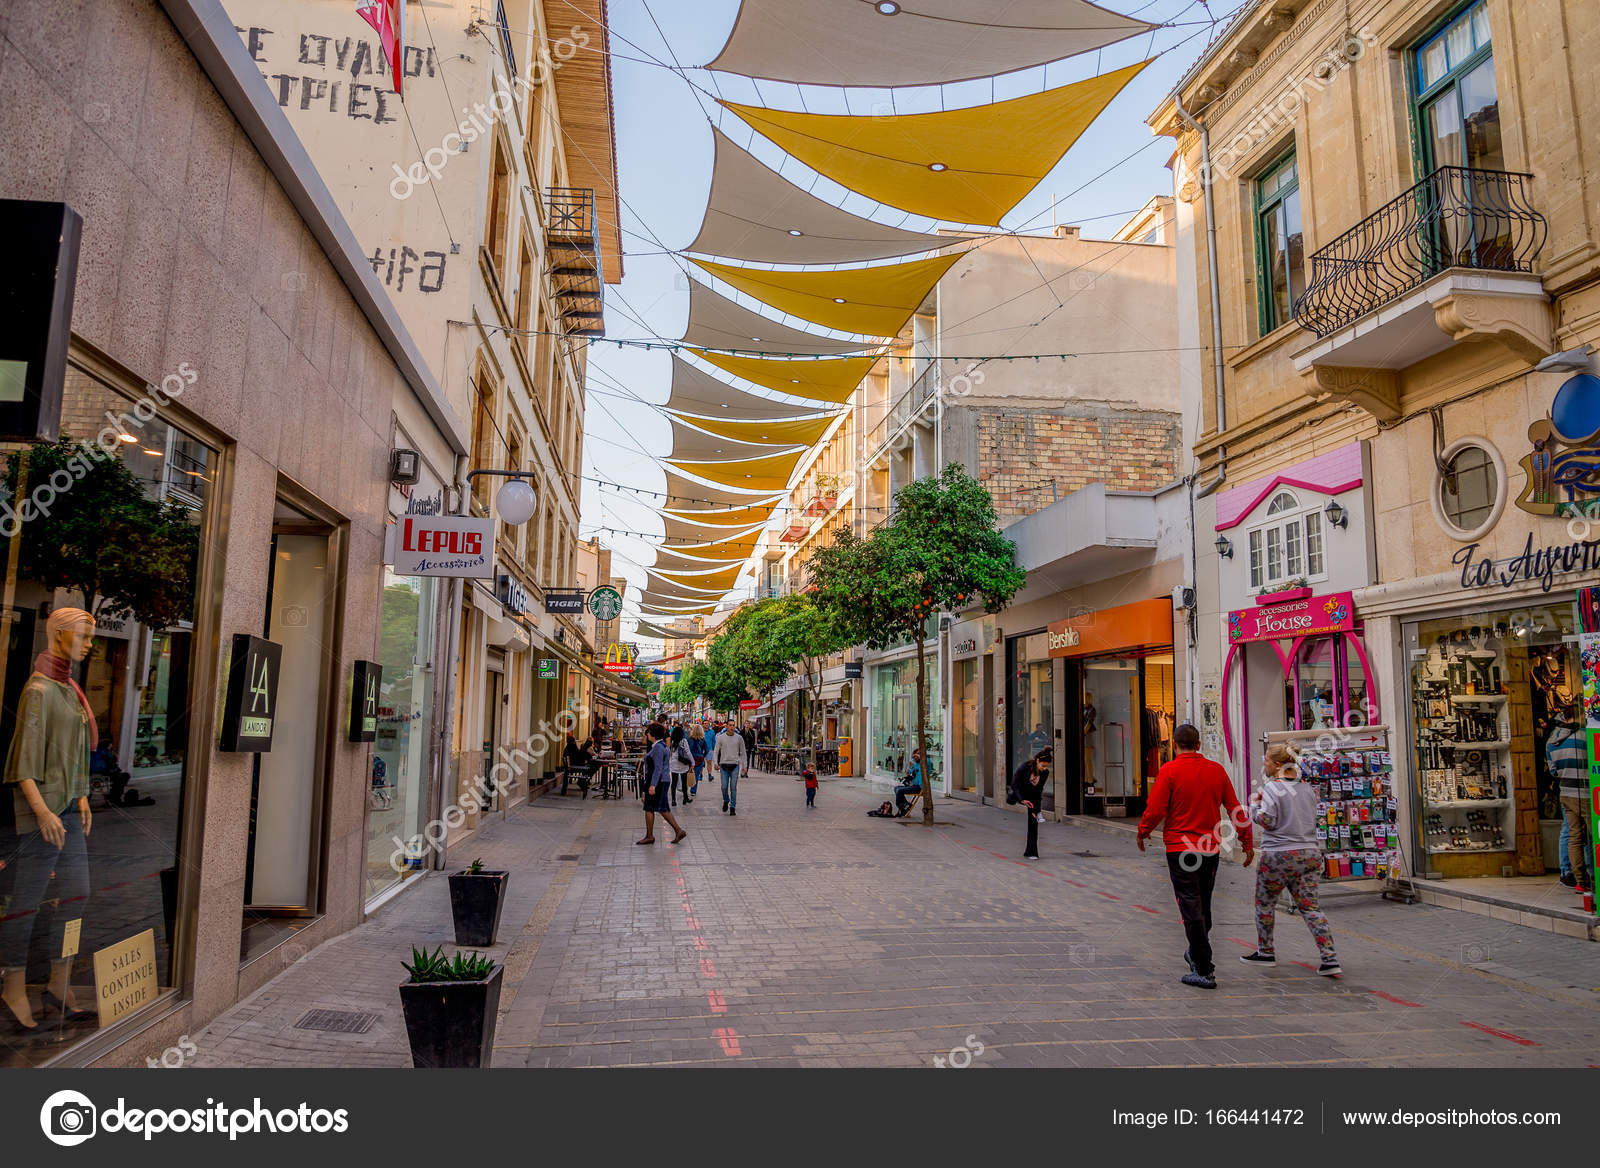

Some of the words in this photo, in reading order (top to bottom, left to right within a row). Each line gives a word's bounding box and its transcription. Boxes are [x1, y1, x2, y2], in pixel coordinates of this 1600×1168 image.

[262, 73, 398, 125] ΤΡΙΕΣ
[402, 517, 483, 555] LEPUS
[507, 577, 528, 616] TIGER
[547, 600, 582, 608] TIGER
[1258, 601, 1309, 616] accessories
[1048, 626, 1080, 650] Bershka
[1253, 614, 1313, 637] House
[112, 947, 142, 972] SALES
[102, 962, 154, 999] CONTINUE
[112, 986, 147, 1016] INSIDE
